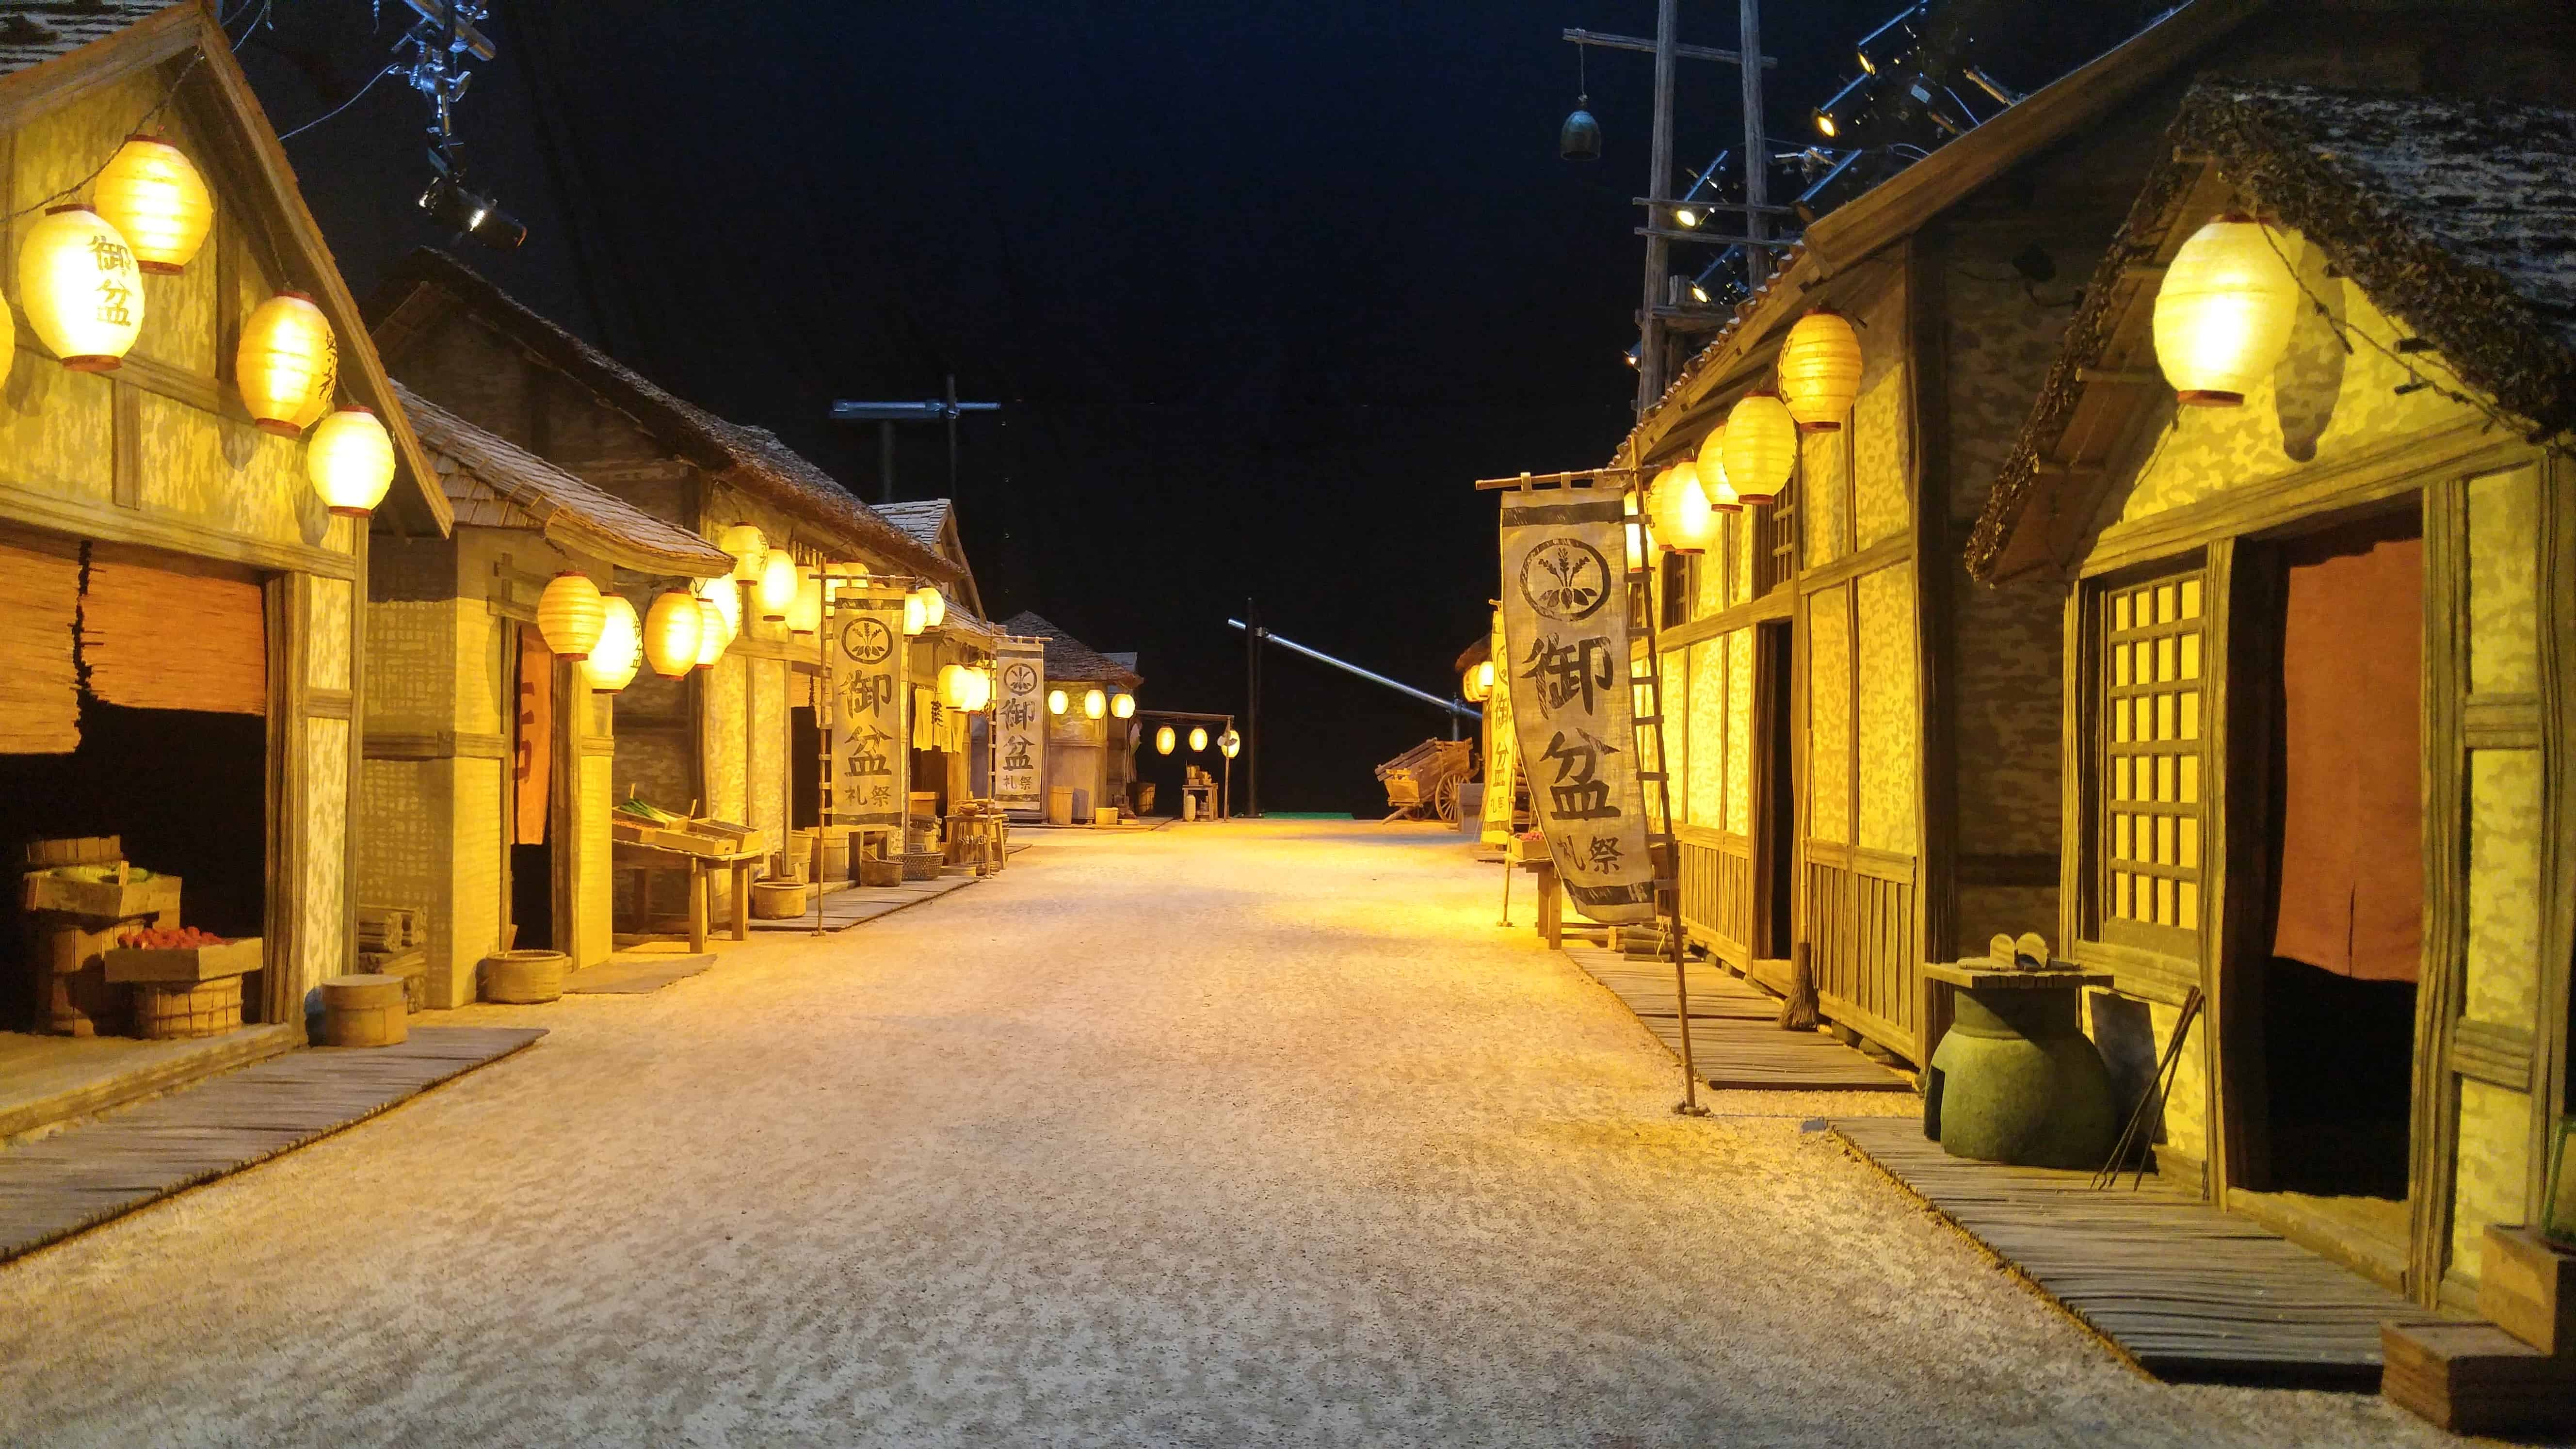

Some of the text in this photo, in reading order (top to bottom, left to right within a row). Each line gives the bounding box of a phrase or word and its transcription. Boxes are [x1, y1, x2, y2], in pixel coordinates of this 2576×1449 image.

[838, 669, 893, 776] 御盆
[999, 698, 1036, 771] 御盆
[1520, 632, 1622, 821] 御盆
